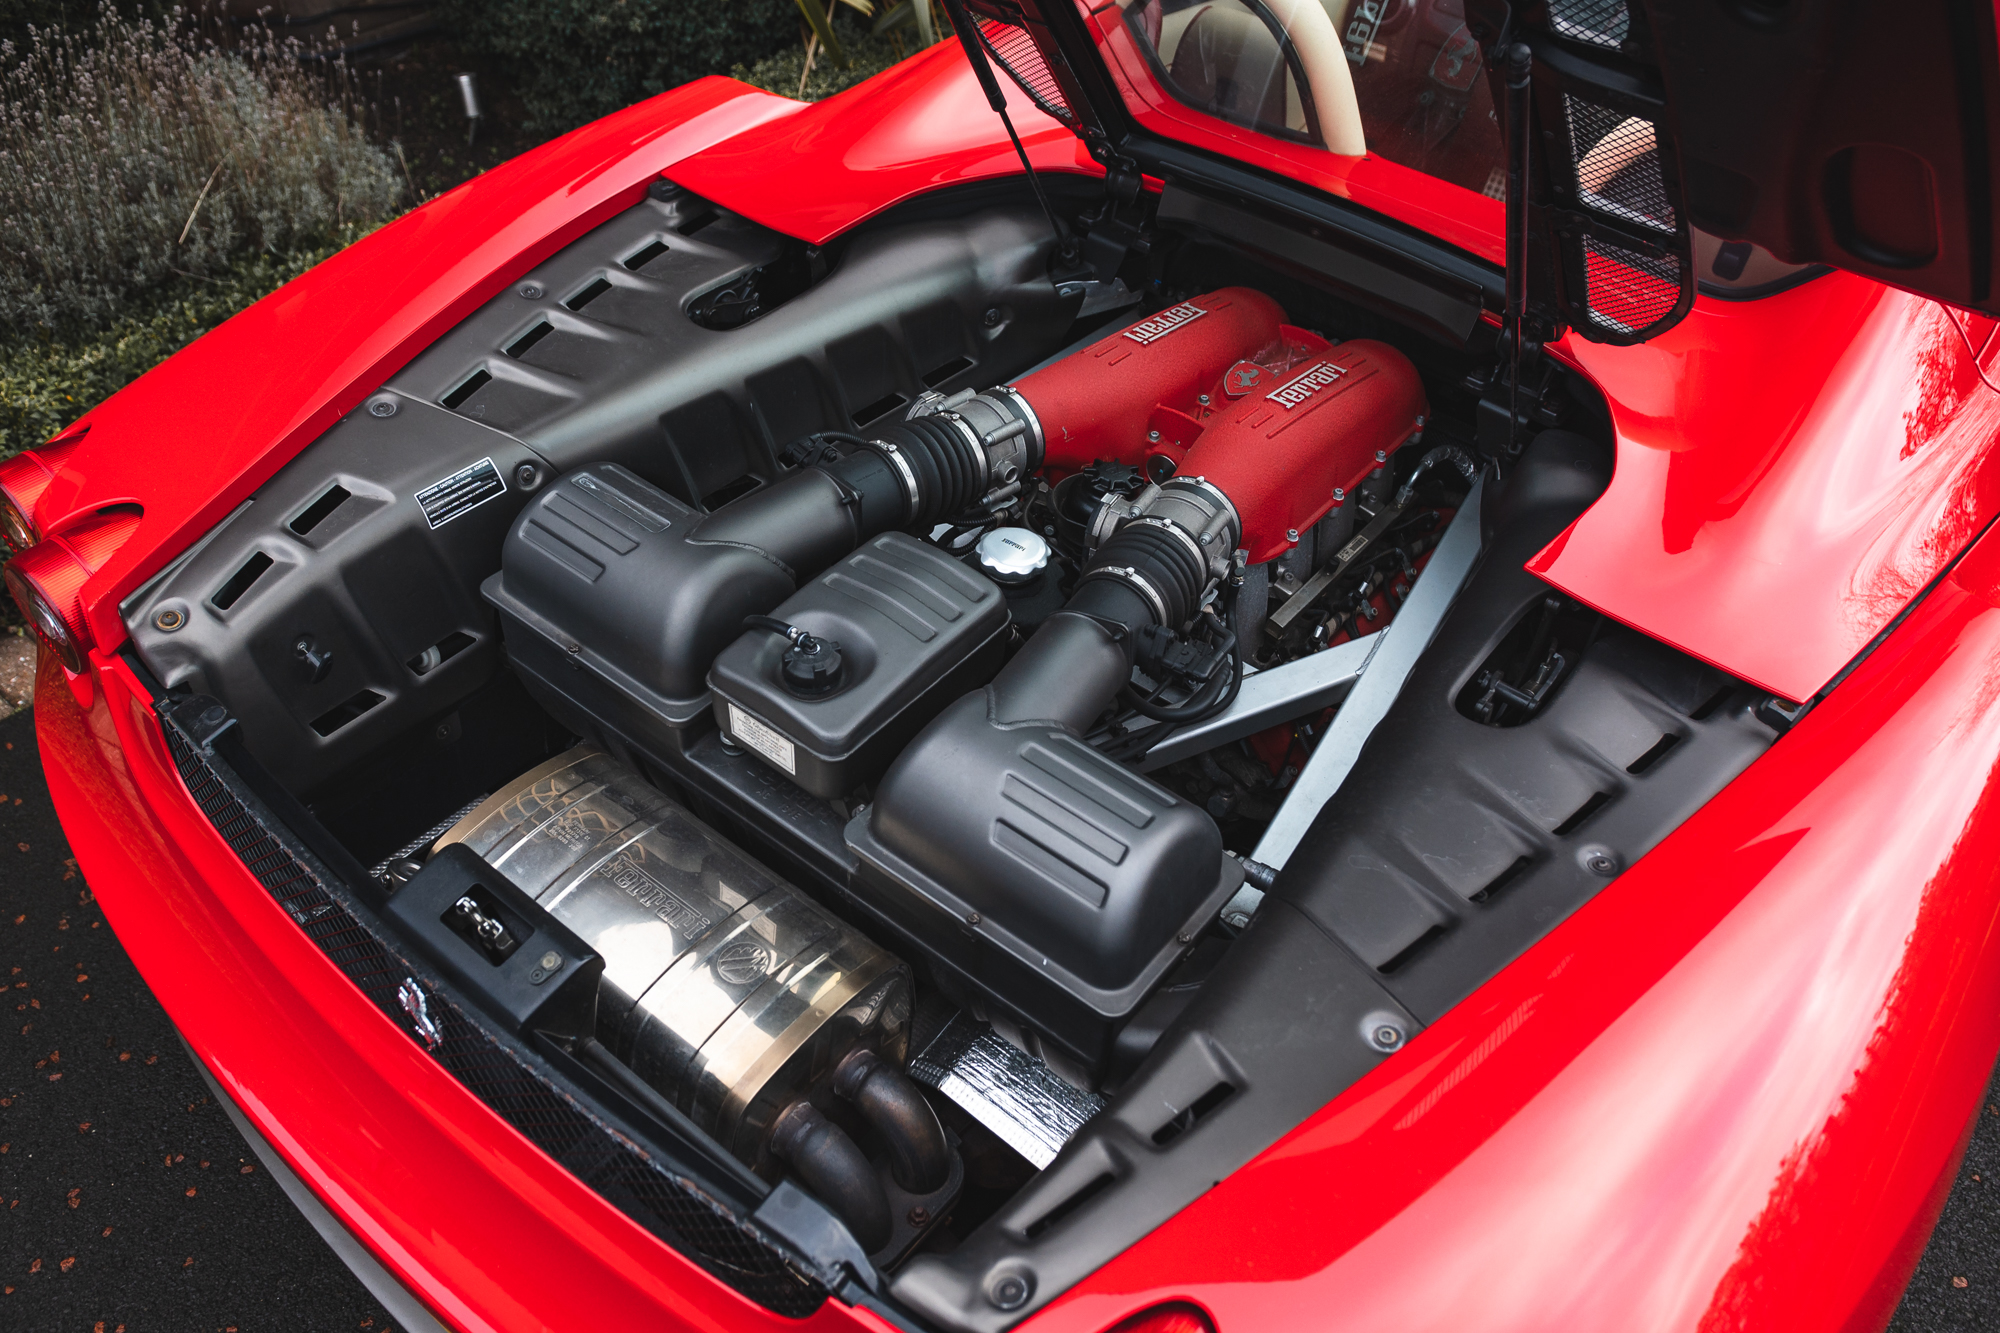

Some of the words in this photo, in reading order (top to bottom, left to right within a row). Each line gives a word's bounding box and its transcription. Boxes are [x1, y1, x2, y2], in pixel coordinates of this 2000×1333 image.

[1123, 302, 1208, 344] Ferrari
[1265, 361, 1348, 409] Ferrari
[1001, 538, 1026, 552] Ferrari
[600, 855, 711, 941] Ferrari
